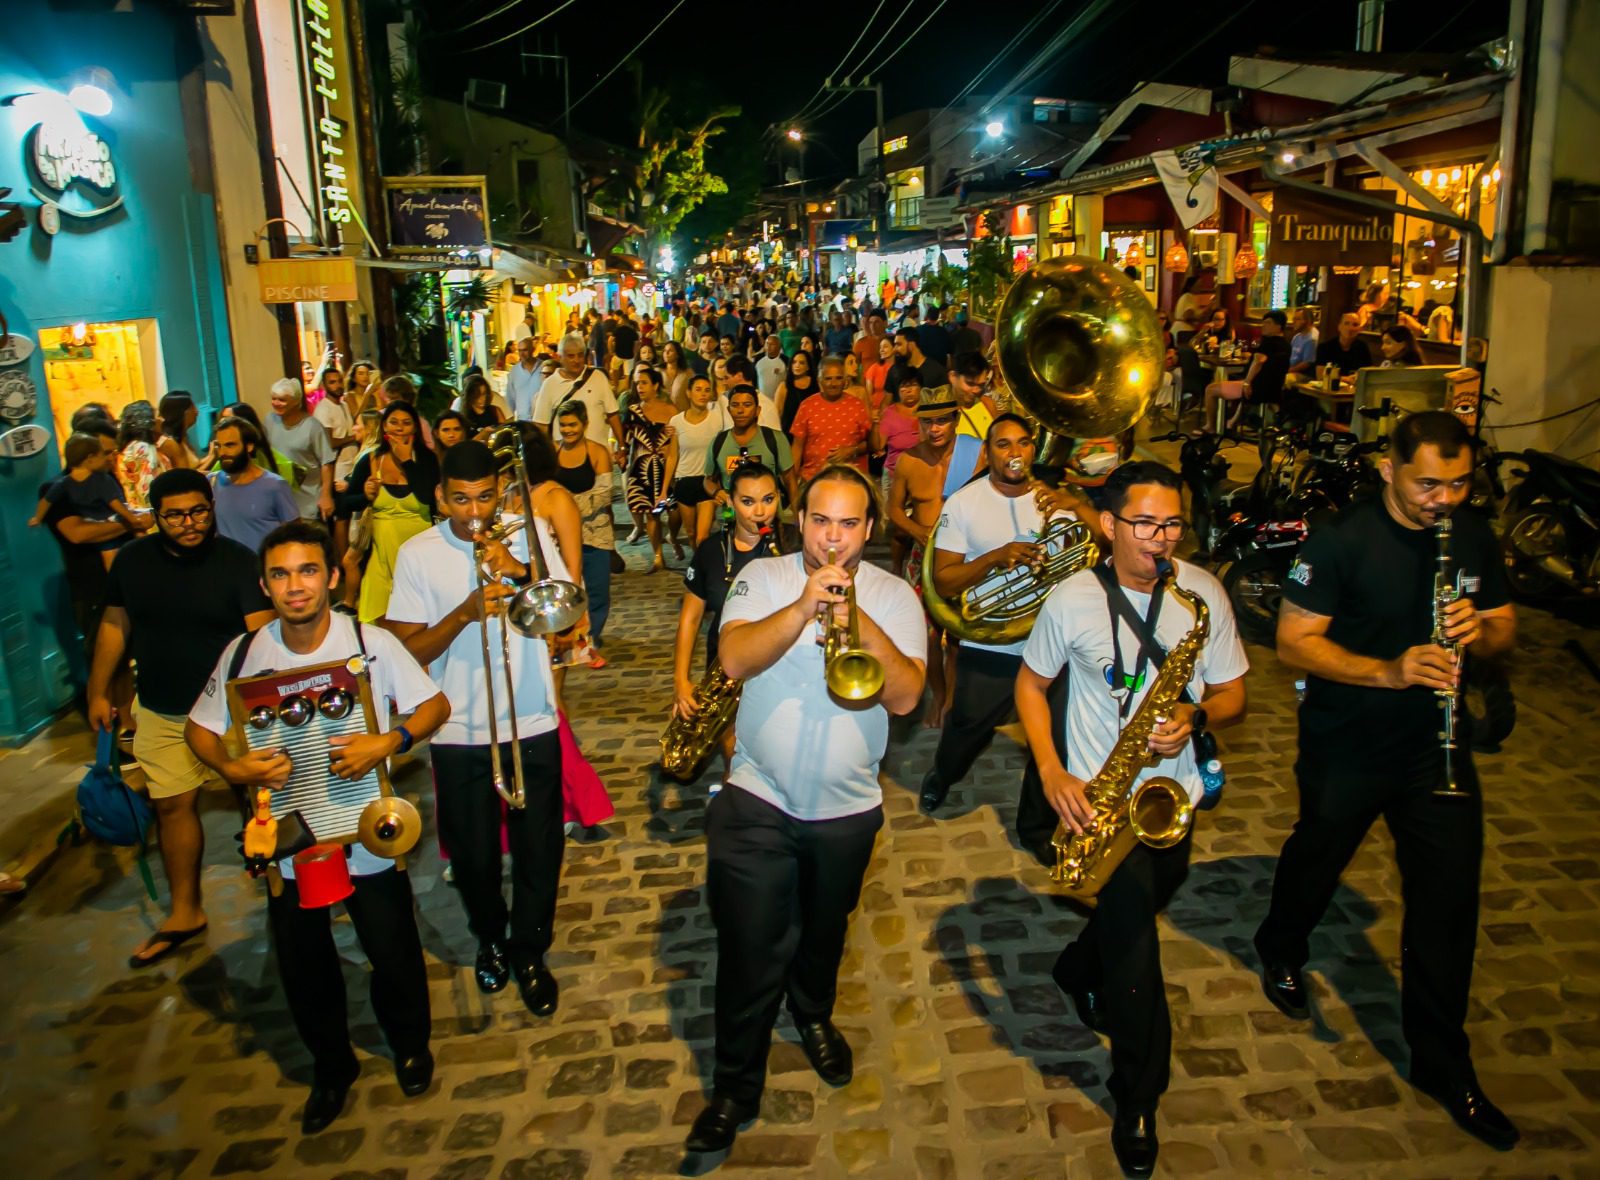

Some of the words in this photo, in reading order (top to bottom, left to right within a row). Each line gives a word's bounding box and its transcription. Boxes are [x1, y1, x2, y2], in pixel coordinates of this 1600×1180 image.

[307, 0, 338, 100] LOLLA
[319, 117, 351, 224] SANTA
[1278, 214, 1392, 251] Tranquilo
[265, 285, 329, 300] PISCINE
